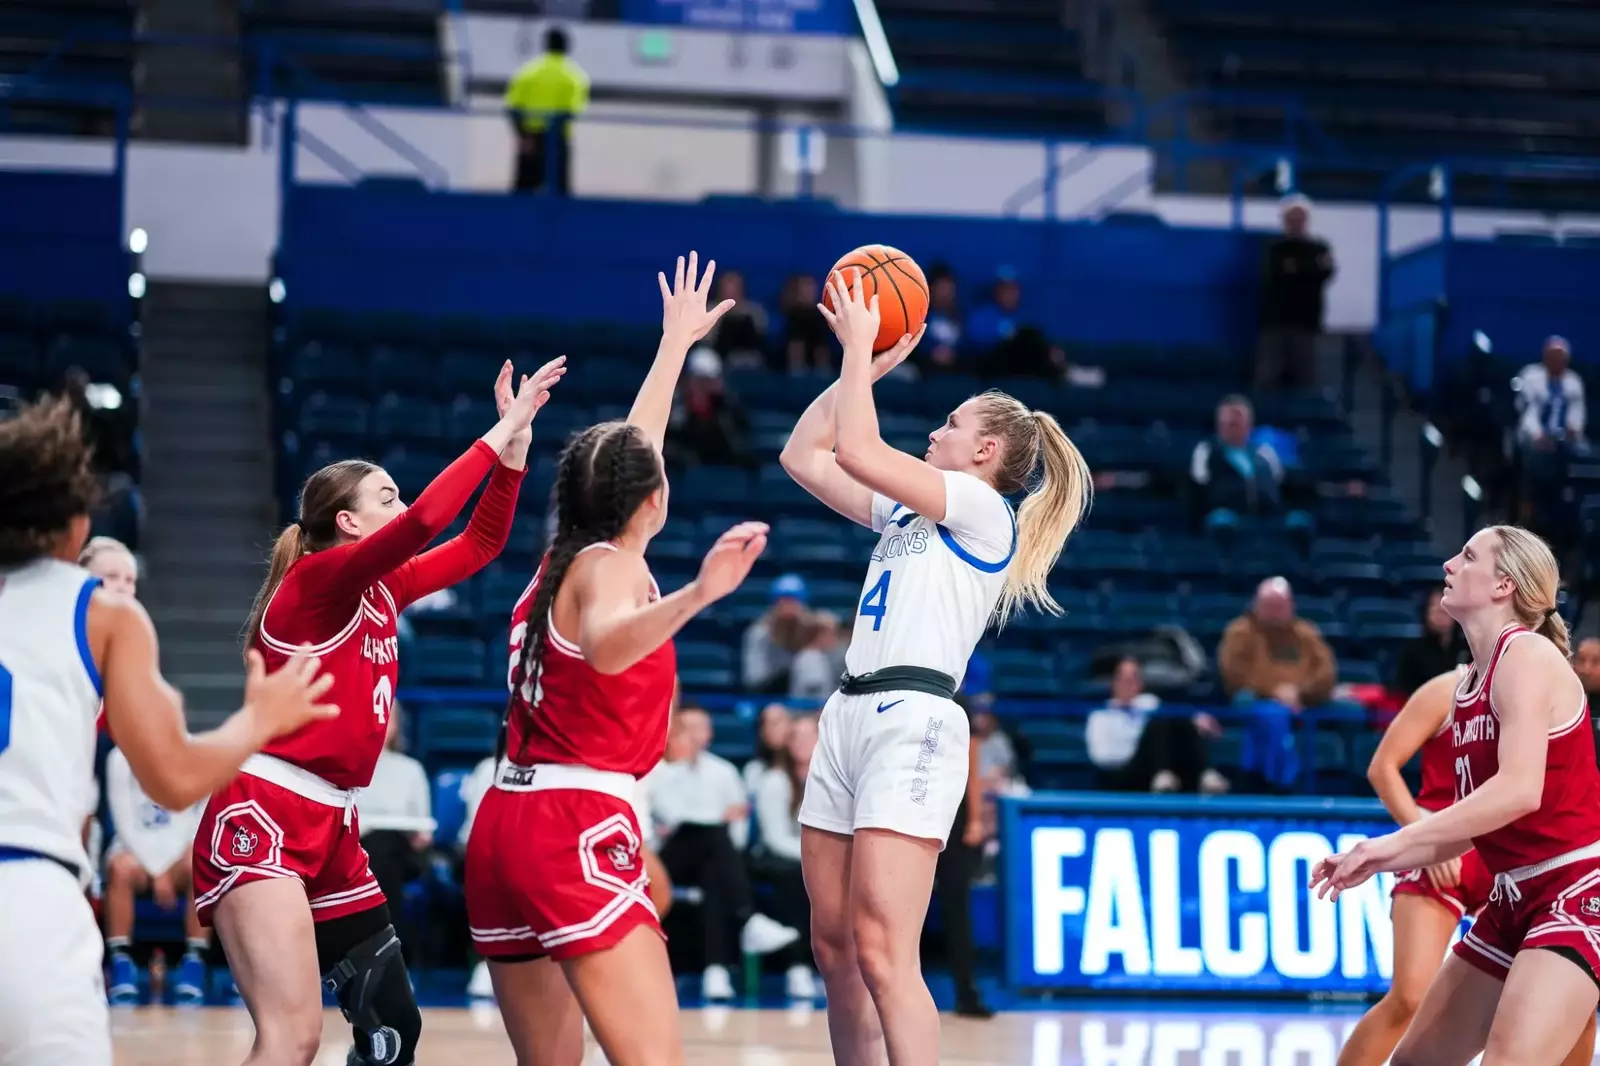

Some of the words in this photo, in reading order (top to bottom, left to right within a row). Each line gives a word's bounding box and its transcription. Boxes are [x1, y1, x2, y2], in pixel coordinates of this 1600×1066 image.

[859, 570, 892, 632] 4
[915, 716, 943, 776] FORCE
[910, 777, 928, 806] AIR
[1030, 827, 1474, 981] FALCON
